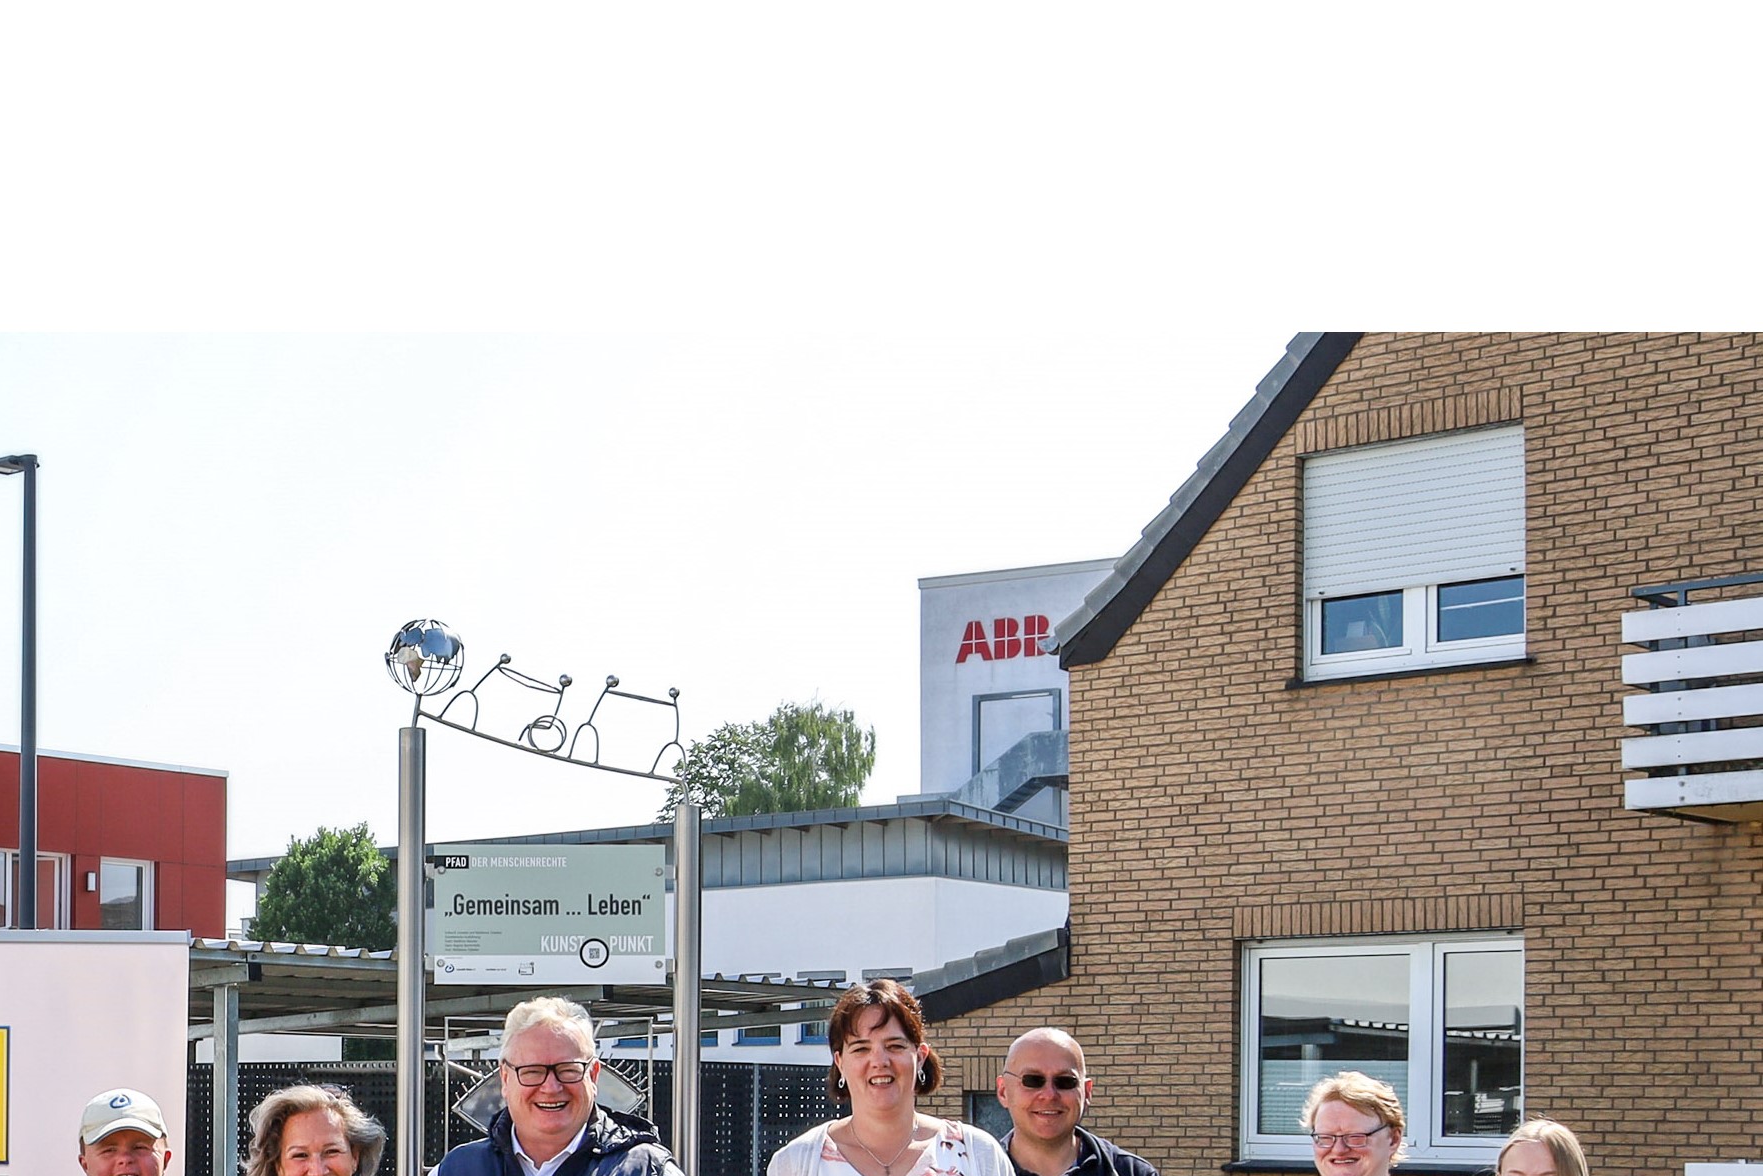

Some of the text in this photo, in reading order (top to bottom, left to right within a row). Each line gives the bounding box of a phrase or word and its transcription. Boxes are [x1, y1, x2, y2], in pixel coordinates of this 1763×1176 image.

[955, 614, 1050, 664] ABB
[445, 857, 567, 868] PFAD DER MENSCHENRECHTE
[541, 936, 653, 952] KUNST PUNKT
